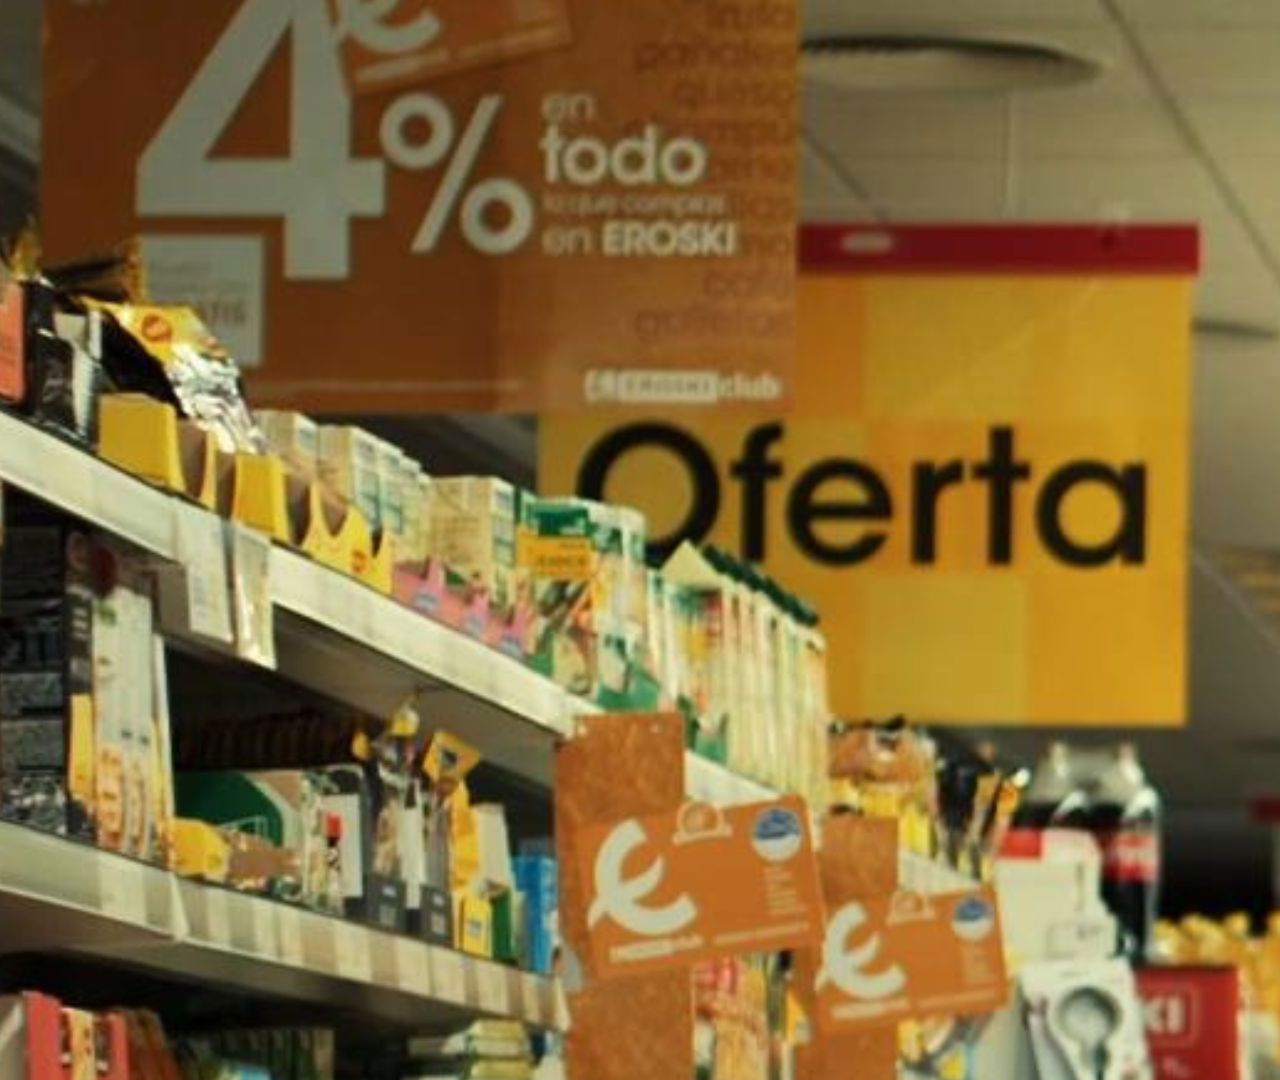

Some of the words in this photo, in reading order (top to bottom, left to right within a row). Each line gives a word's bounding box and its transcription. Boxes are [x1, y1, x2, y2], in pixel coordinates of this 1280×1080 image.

[541, 94, 596, 120] en
[540, 123, 707, 186] todo
[542, 227, 591, 255] en
[602, 220, 739, 256] EROSKI
[576, 420, 1147, 570] Oferta
